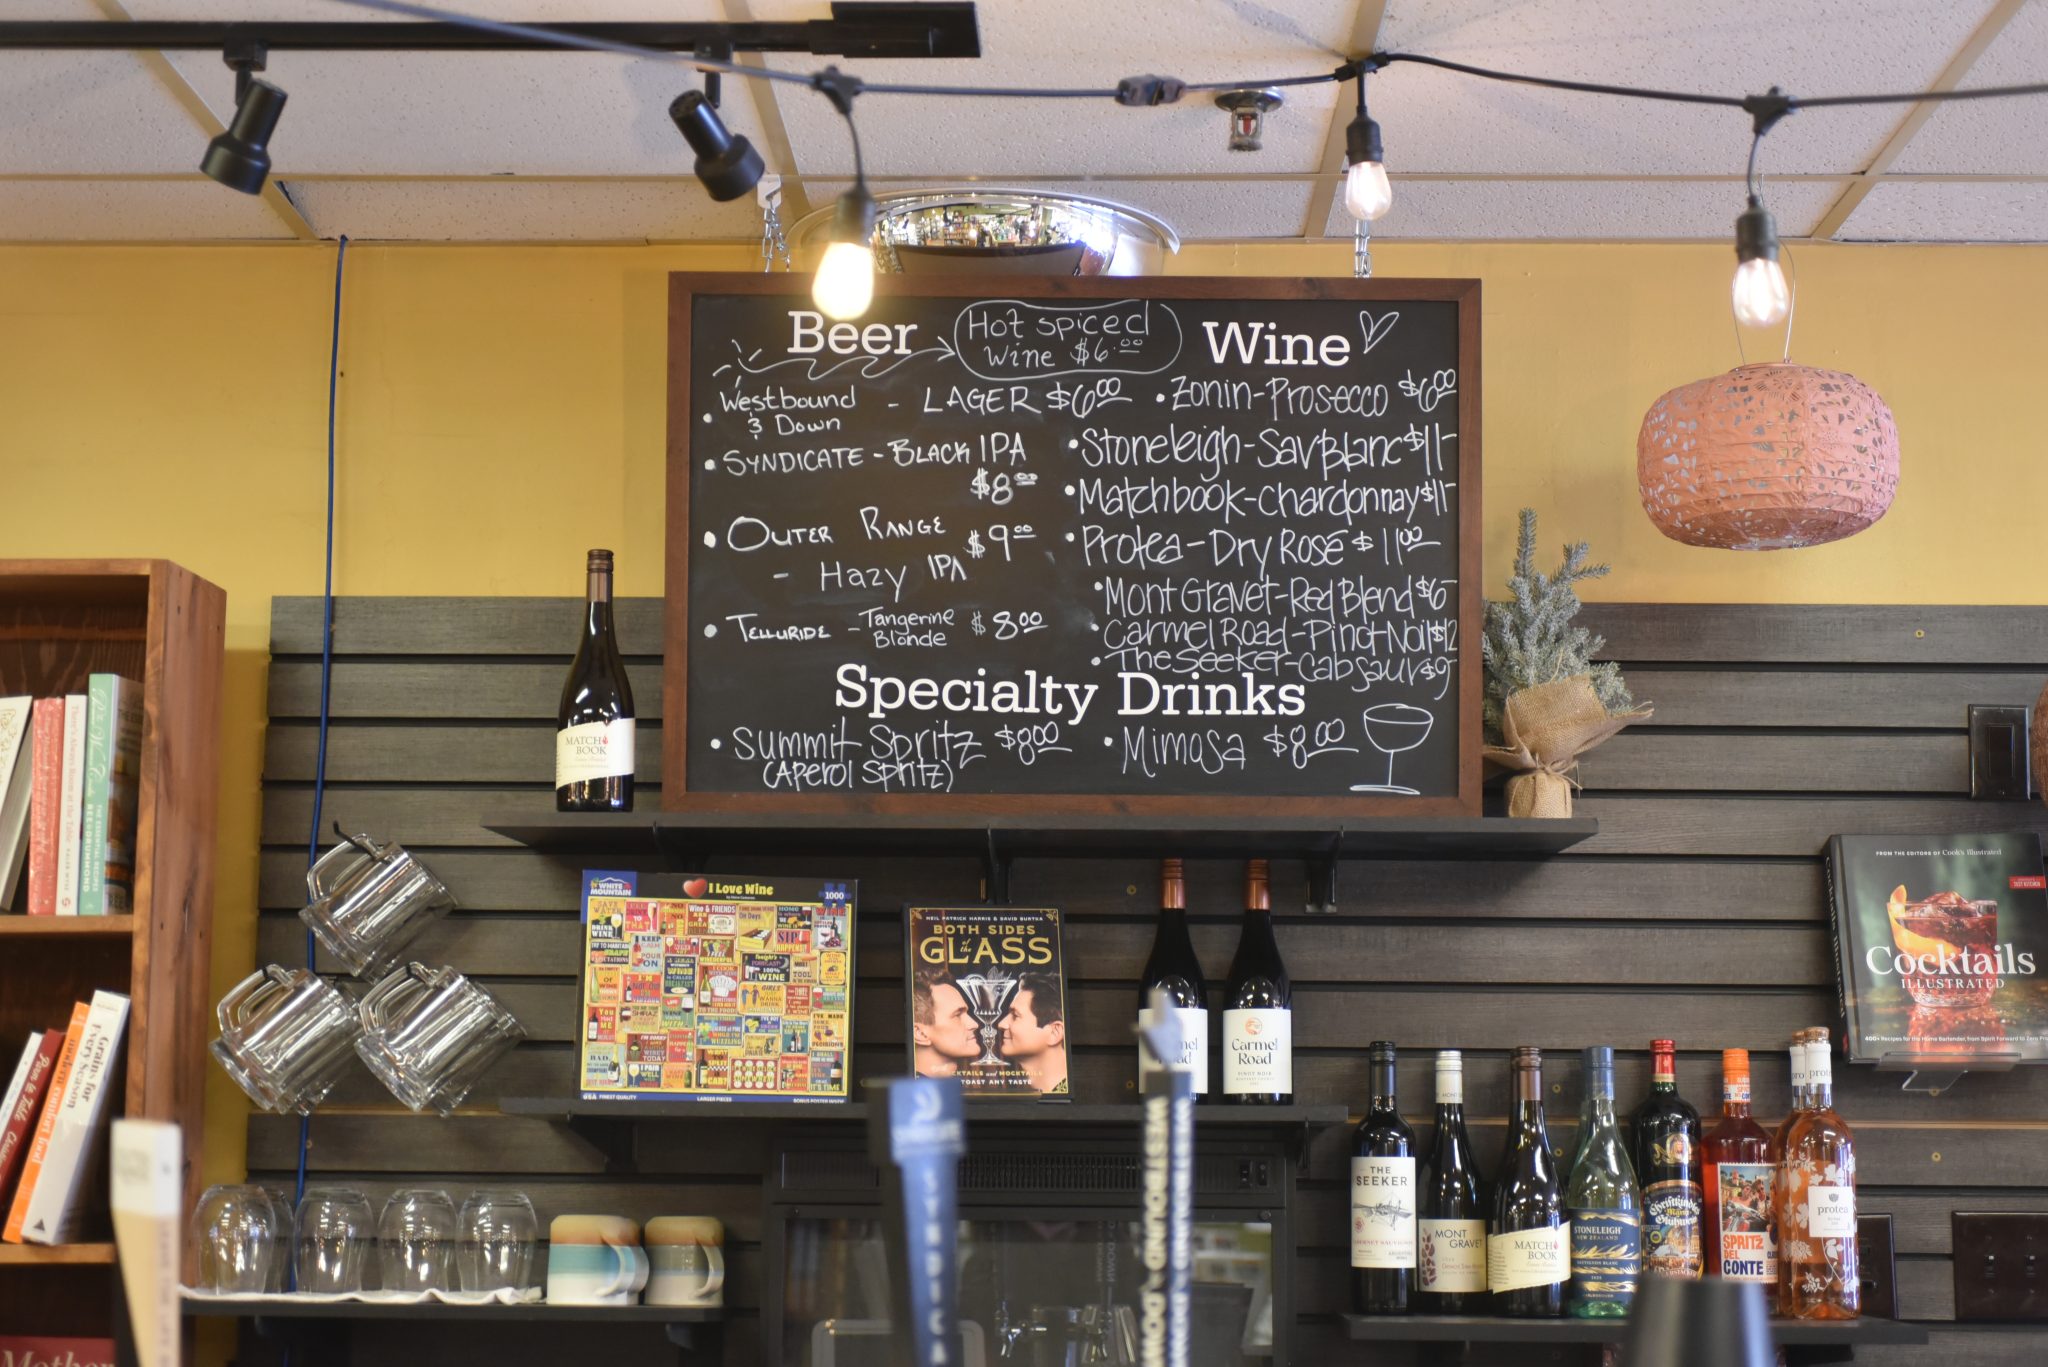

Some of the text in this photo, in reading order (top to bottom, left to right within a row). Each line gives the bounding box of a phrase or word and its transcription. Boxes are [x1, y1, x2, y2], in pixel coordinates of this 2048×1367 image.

[969, 308, 1024, 340] Hot
[787, 311, 918, 355] Beer
[1202, 322, 1350, 366] Wine
[720, 385, 856, 413] Westbound
[923, 386, 1042, 415] LAGER
[776, 415, 841, 435] Down
[980, 433, 1027, 466] IPA
[820, 554, 967, 602] Hazy IPA
[1106, 576, 1177, 618] Mont
[1338, 574, 1415, 624] Blend
[858, 606, 954, 631] Tangerine
[875, 630, 948, 648] Blonde
[1104, 619, 1214, 650] Carmel
[1104, 647, 1172, 671] The
[836, 663, 1306, 725] Specialty Drinks
[565, 736, 601, 745] MATCH
[732, 717, 862, 761] Summit
[870, 720, 986, 768] Spritz
[576, 746, 607, 755] BOOK
[1122, 726, 1246, 777] Mimosa
[599, 882, 623, 890] WHITE
[708, 883, 774, 896] I Love Wine
[825, 892, 844, 900] 1000
[712, 905, 736, 914] FRIENDS
[933, 925, 1036, 935] BOTH SIDES
[920, 937, 1052, 965] GLASS
[1866, 943, 2036, 976] Cocktails
[1901, 978, 2005, 989] ILLUSTRATED
[1232, 1038, 1278, 1051] Carmel
[1238, 1052, 1272, 1065] Road
[66, 1023, 102, 1110] Every Season
[80, 1036, 110, 1103] Grains for
[1370, 1166, 1391, 1174] THE
[1356, 1176, 1408, 1186] SEEKER
[1817, 1205, 1849, 1215] protea
[1435, 1229, 1467, 1238] MONT
[1574, 1226, 1622, 1235] STONELEIGH
[1449, 1239, 1483, 1249] GRAVET
[1514, 1241, 1553, 1250] MATCH
[1723, 1233, 1764, 1250] SPRITZ
[1528, 1251, 1557, 1260] BOOK
[1724, 1249, 1740, 1259] DEL
[1723, 1261, 1764, 1275] CONTE
